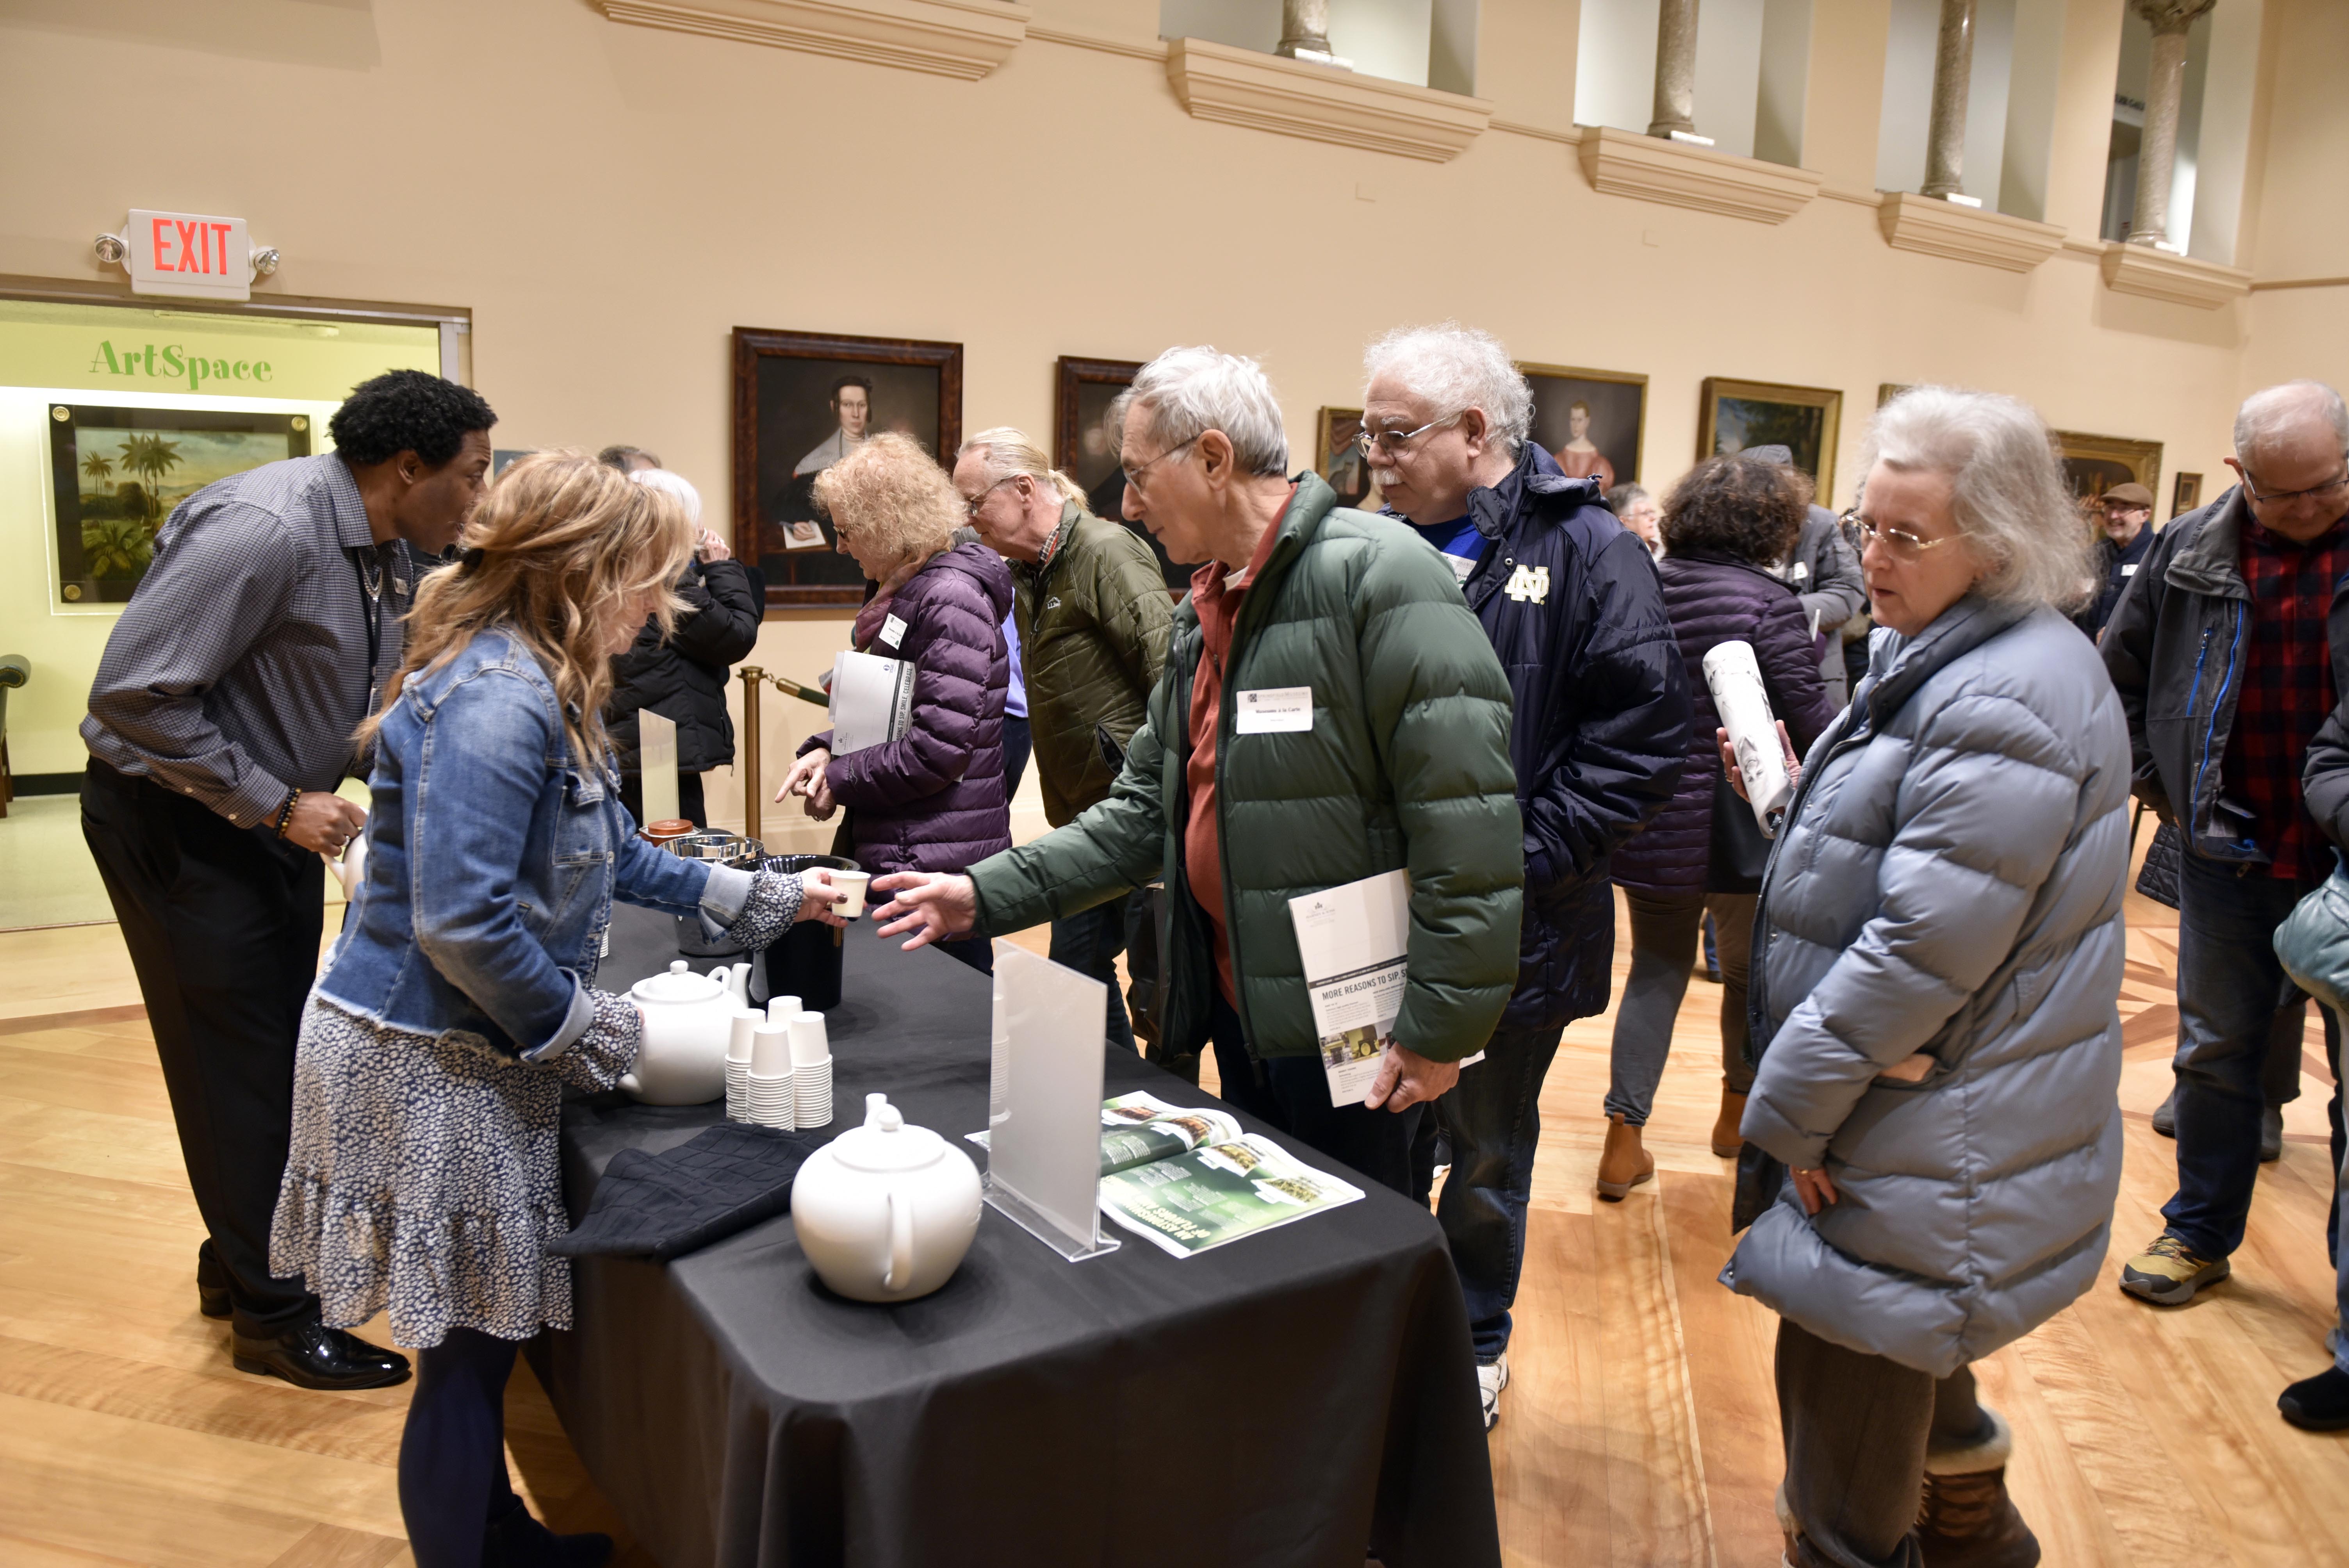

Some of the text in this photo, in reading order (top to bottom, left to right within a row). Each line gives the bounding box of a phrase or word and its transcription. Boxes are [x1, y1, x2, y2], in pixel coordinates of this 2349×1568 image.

[152, 218, 232, 275] EXIT
[88, 340, 273, 391] ArtSpace
[903, 668, 913, 694] CELEBRATE
[900, 696, 909, 710] SMILE,
[1322, 987, 1343, 1001] MORE
[1344, 978, 1376, 994] REASONS
[1377, 976, 1386, 985] TO
